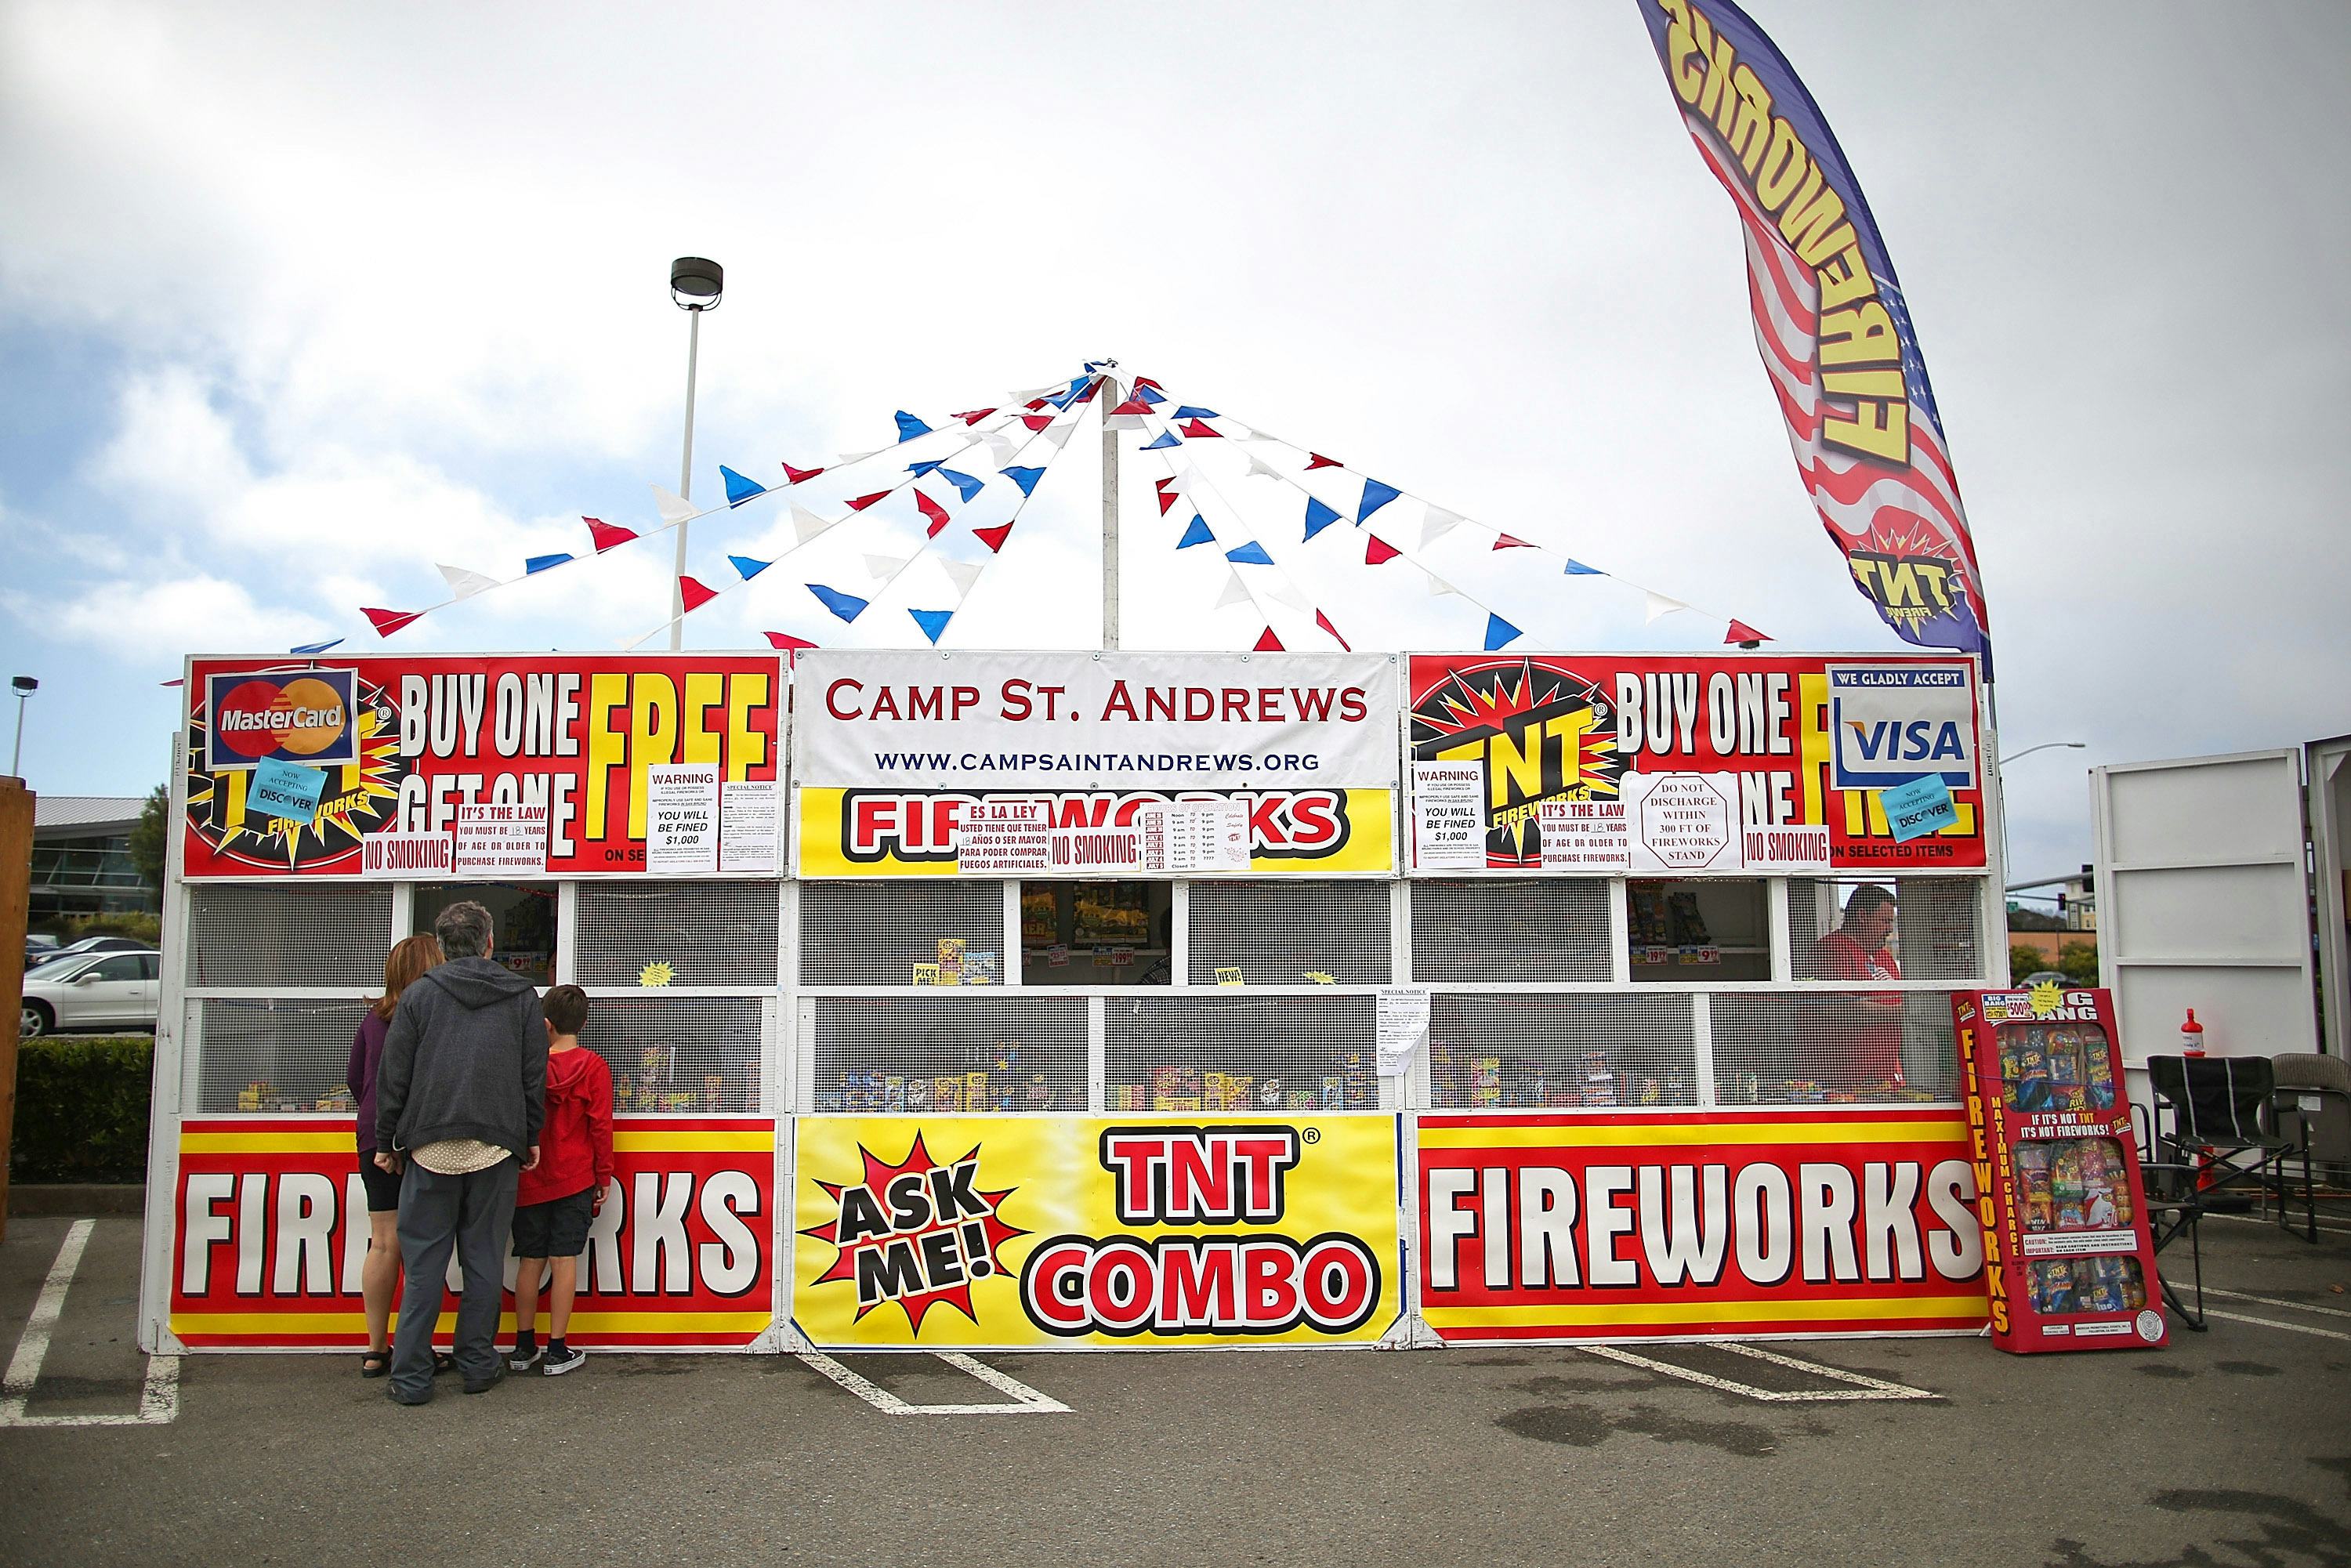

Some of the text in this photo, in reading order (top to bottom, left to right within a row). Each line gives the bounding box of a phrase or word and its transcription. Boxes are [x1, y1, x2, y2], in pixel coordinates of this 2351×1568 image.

[1836, 672, 1959, 686] WE GLADLY ACCEPT
[220, 705, 342, 731] MasterCard
[400, 672, 580, 758] BUY ONE
[1615, 672, 1699, 755] BUY
[1708, 671, 1792, 755] ONE
[1843, 720, 1965, 761] VISA
[585, 673, 770, 840] FREE
[874, 753, 1319, 772] WWW.CAMPSAINTANDREWS.ORG
[282, 770, 300, 780] NOW
[652, 773, 714, 784] WARNING
[1417, 770, 1479, 781] WARNING
[269, 777, 308, 791] ACCEPTING
[1661, 784, 1704, 793] DO NOT
[259, 788, 311, 810] DISCOVER
[1740, 771, 1793, 825] NE
[1905, 788, 1922, 798] NOW
[1147, 802, 1241, 813] HOURS OF OPERATION
[1650, 797, 1717, 806] DISCHARGE
[1899, 793, 1935, 810] ACCEPTING
[267, 791, 369, 835] FIRORKS
[461, 806, 547, 820] IT'S THE LAW
[657, 811, 708, 820] YOU WILL
[970, 806, 1038, 819] ES LA LEY
[1425, 807, 1476, 817] YOU WILL
[1542, 803, 1625, 817] IT'S THE LAW
[1663, 811, 1706, 820] WITHIN
[1899, 803, 1949, 828] DISCOVER
[657, 823, 708, 832] BE FINED
[857, 797, 1333, 847] FIRWKS
[960, 824, 1047, 833] USTED TIENE QUE TENER
[1425, 819, 1476, 829] BE FINED
[1542, 823, 1627, 833] YOU MUST BE 18 YEARS
[1659, 824, 1676, 833] 300
[1679, 824, 1693, 833] FT
[459, 826, 545, 835] YOU MUST BE 18 YEARS
[1435, 831, 1468, 842] $1,000
[665, 835, 699, 846] $1,000
[972, 834, 993, 845] AÑOS
[995, 835, 1001, 845] O
[1002, 835, 1016, 845] SER
[1018, 835, 1047, 845] MAYOR
[1542, 838, 1627, 848] OF AGE OR OLDER TO
[1651, 838, 1720, 846] FIREWORKS
[458, 842, 545, 851] OF AGE OR OLDER TO
[960, 847, 1047, 856] PARA PODER COMPRAR
[1052, 834, 1136, 865] NO SMOKING
[1746, 831, 1828, 862] NO SMOKING
[1830, 846, 1954, 857] ON SELECTED ITEMS
[365, 838, 449, 870] NO SMOKING
[604, 849, 624, 861] ON
[1542, 853, 1627, 863] PURCHASE FIREWORKS.
[1668, 851, 1705, 860] STAND
[458, 856, 544, 866] PURCHASE FIREWORKS.
[960, 860, 1047, 870] FUEGOS ARTIFICIALES.
[915, 968, 936, 977] PICK
[1218, 970, 1242, 983] NEW!
[2039, 1006, 2098, 1020] ANG
[2031, 1113, 2094, 1125] IF IT'S NOT TNT
[1991, 1096, 2010, 1178] MAXIMUM
[2020, 1124, 2110, 1138] IT'S NOT FIREWORKS!
[1106, 1131, 1296, 1220] TNT
[1961, 1028, 2009, 1334] FIREWORKS
[838, 1161, 989, 1245] ASK
[1429, 1160, 1983, 1289] FIREWORKS
[2002, 1181, 2020, 1257] CHARGE
[181, 1170, 762, 1297] FIRRKS
[857, 1220, 995, 1305] ME!
[1023, 1237, 1378, 1332] COMBO
